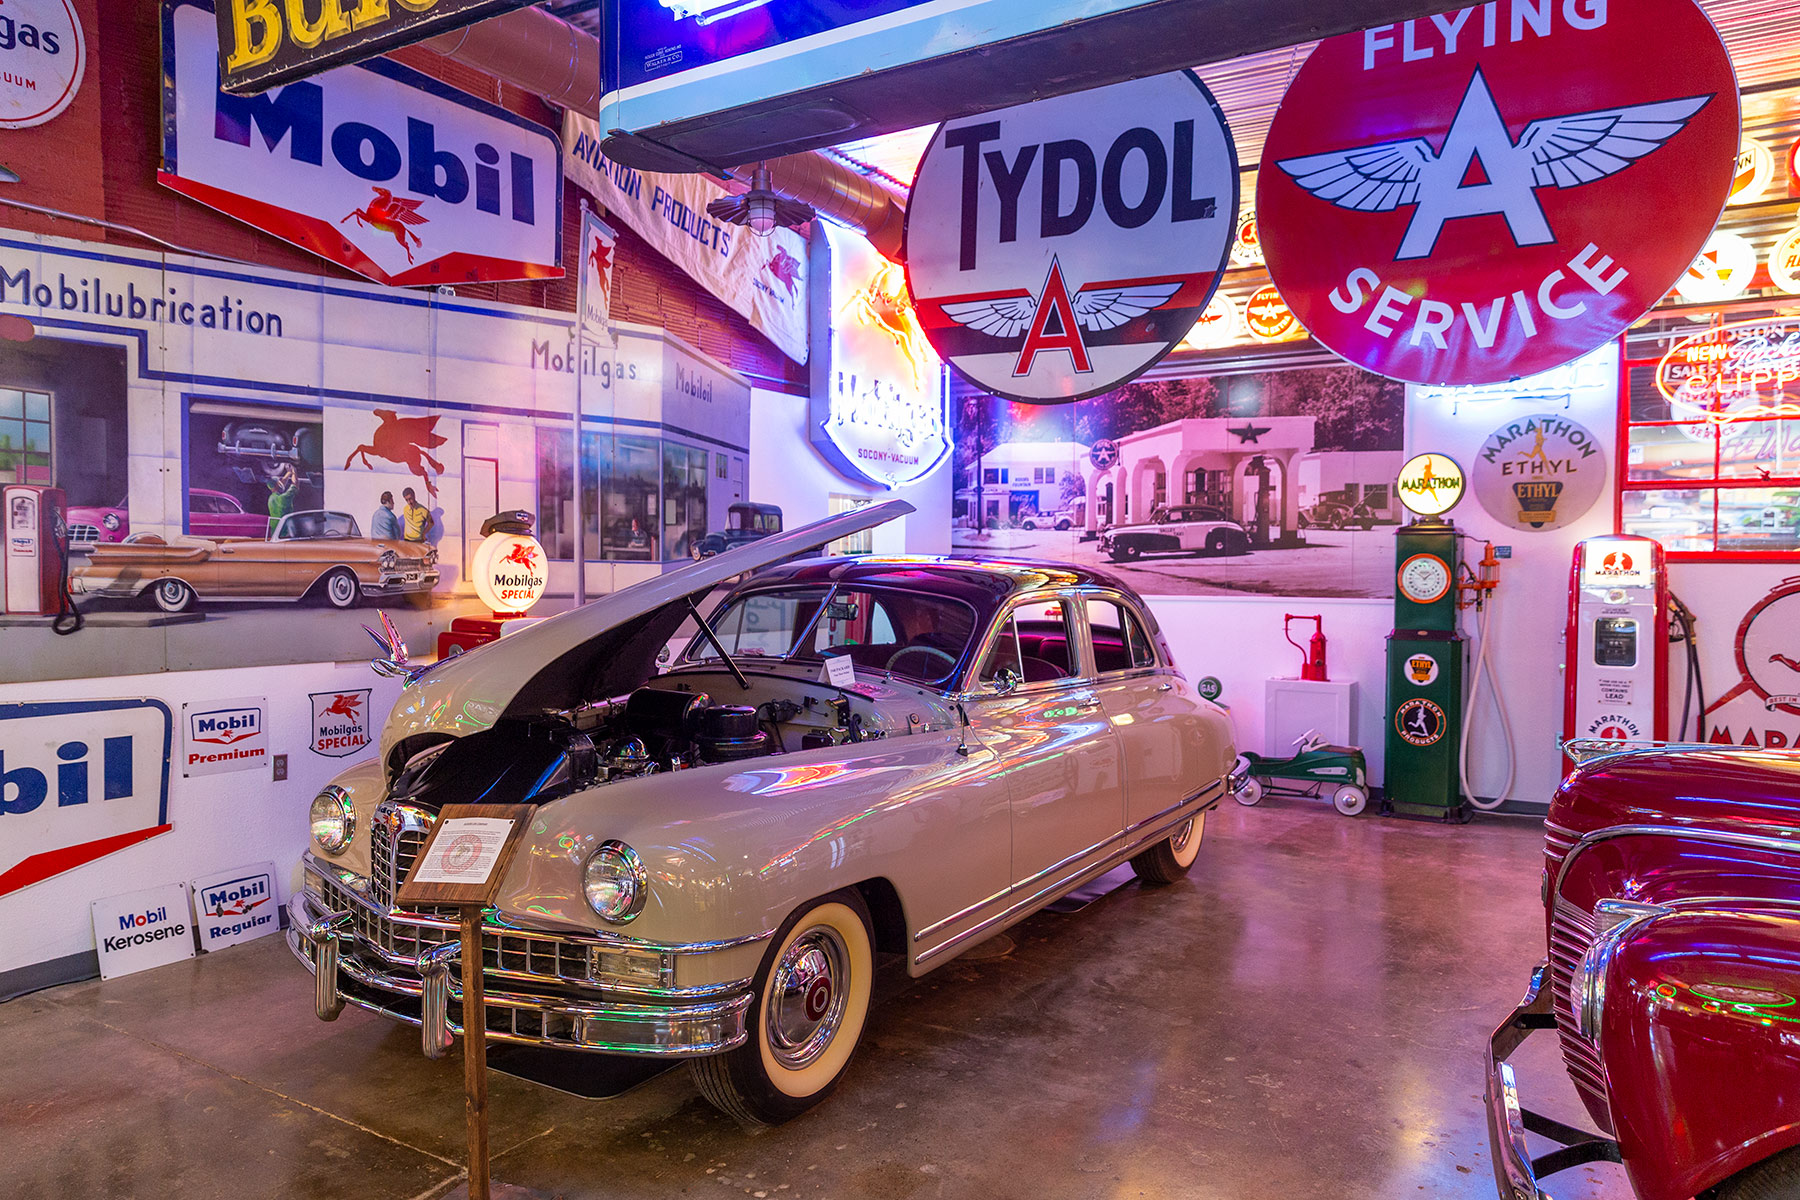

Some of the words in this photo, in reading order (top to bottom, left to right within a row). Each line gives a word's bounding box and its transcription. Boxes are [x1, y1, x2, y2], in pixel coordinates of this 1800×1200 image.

[1363, 0, 1608, 71] FLYING
[214, 80, 535, 226] Mobil
[945, 119, 1216, 271] TYDOL
[651, 185, 731, 259] PRODUCTS
[0, 265, 282, 338] Mobilubrication
[1328, 241, 1629, 350] SERVICE
[1687, 344, 1728, 362] NEW
[531, 338, 637, 389] Mobilgas
[675, 362, 713, 404] Mobiloil
[1481, 418, 1598, 465] MARATHON
[858, 447, 919, 466] SOCONY-VACUUM
[1502, 460, 1578, 477] ETHYL
[1401, 476, 1460, 490] MARATHON
[1517, 483, 1560, 498] ETHYL
[494, 574, 543, 589] Mobilgas
[501, 589, 535, 600] SPECIAL
[1201, 684, 1217, 692] GAS
[1399, 700, 1442, 716] MARATHON
[198, 713, 255, 733] Mobil
[319, 724, 363, 738] Mobilgas
[1588, 714, 1641, 738] MARATHON
[317, 733, 366, 751] SPECIAL
[1401, 730, 1440, 745] PRODUCTS
[188, 747, 265, 765] Premium
[209, 880, 265, 907] Mobil
[119, 906, 167, 931] Mobil
[103, 923, 186, 953] Kerosene
